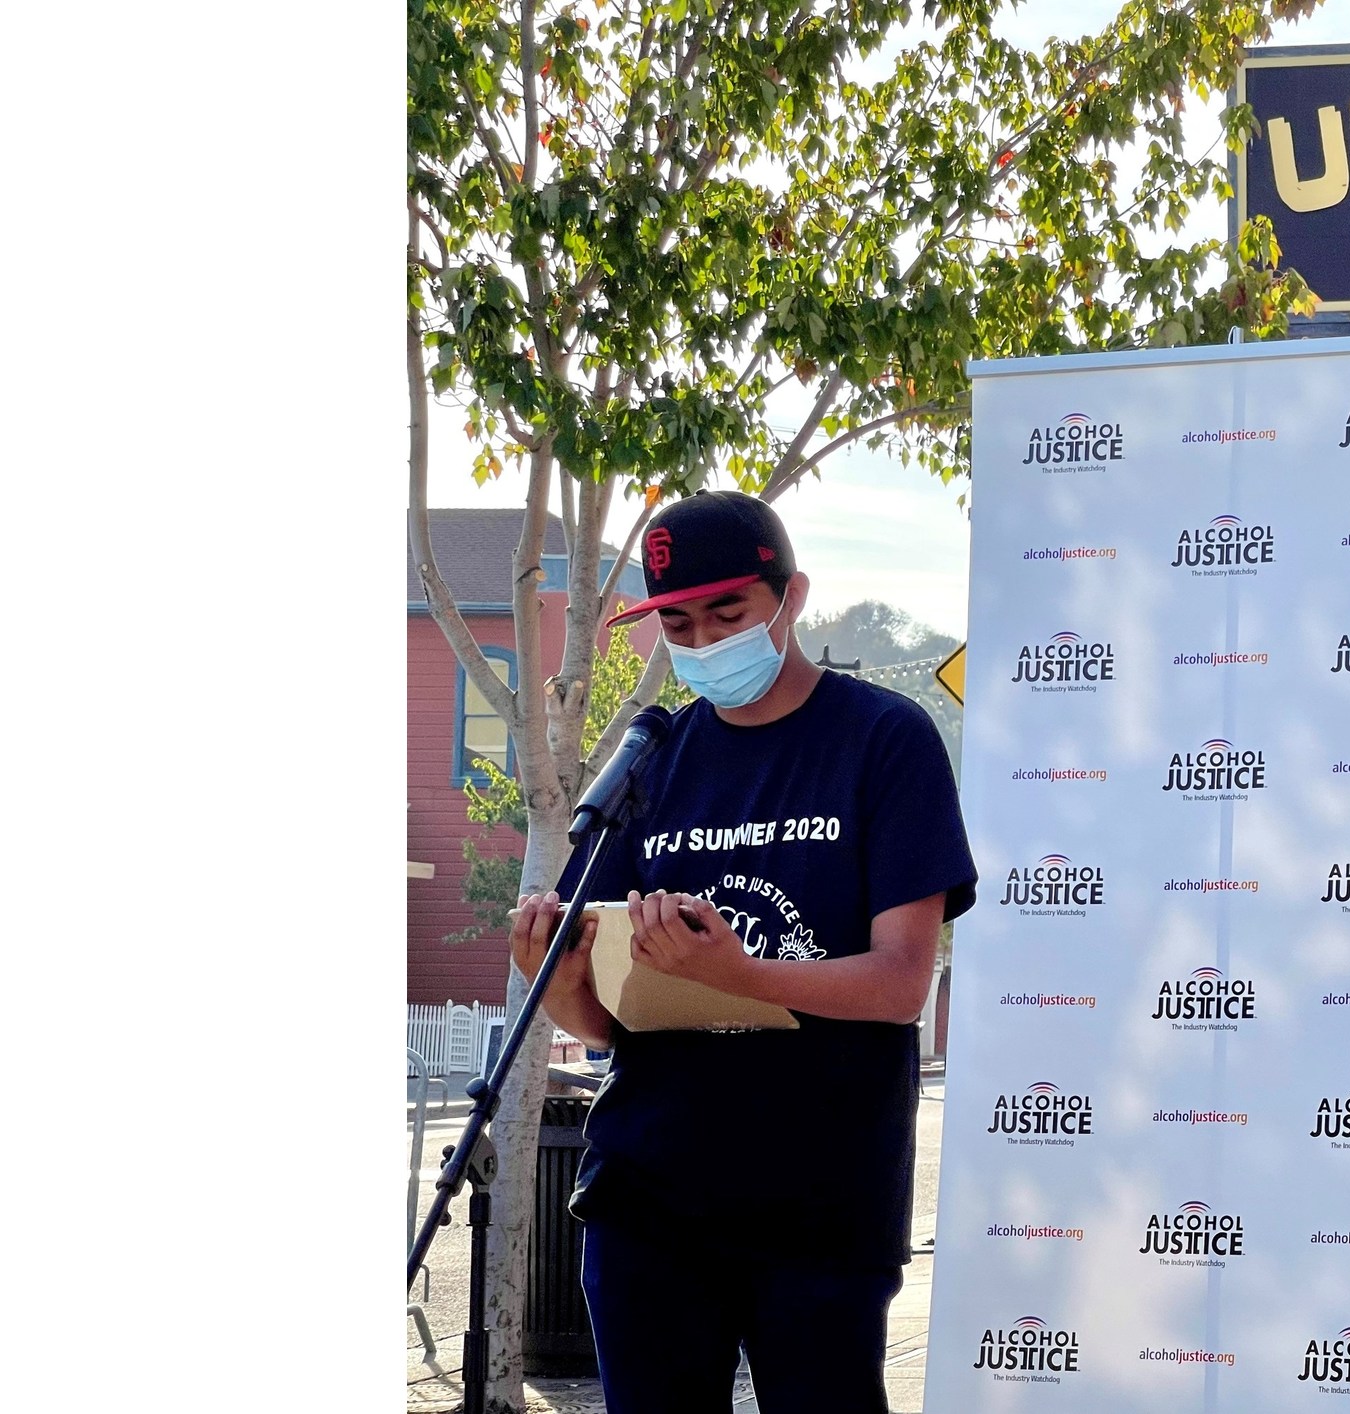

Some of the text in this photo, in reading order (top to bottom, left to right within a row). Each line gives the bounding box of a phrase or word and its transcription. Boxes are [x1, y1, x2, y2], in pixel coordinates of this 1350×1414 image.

[1029, 423, 1124, 442] ALCOHOL
[1181, 428, 1276, 445] alcoholjustice.org
[1022, 439, 1123, 465] JUSTICE
[1053, 466, 1077, 474] Industry
[1076, 464, 1107, 473] Watchdog
[1178, 525, 1274, 545] ALCOHOL
[1023, 547, 1117, 562] alcoholjustice.org
[1170, 541, 1274, 568] JUSTICE
[1203, 569, 1228, 578] Industry
[1227, 567, 1258, 576] Watchdog
[1018, 642, 1115, 660] ALCOHOL
[1173, 651, 1268, 668] alcoholjustice.org
[1010, 659, 1117, 683] JUSTICE
[1030, 684, 1097, 693] The Industry Watchdog
[1169, 750, 1266, 768] ALCOHOL
[1011, 767, 1107, 783] alcoholjustice.org
[1161, 767, 1265, 792] JUSTICE
[1193, 794, 1219, 803] Industry
[1218, 792, 1249, 802] Watchdog
[644, 816, 841, 859] YFJ SUMMER 2020
[1007, 866, 1104, 883] ALCOHOL
[999, 883, 1104, 906] JUSTICE
[1163, 878, 1259, 894] alcoholjustice.org
[747, 876, 801, 925] JUSTICE
[1019, 908, 1087, 918] The Industry Watchdog
[1158, 979, 1256, 997] ALCOHOL
[999, 992, 1096, 1009] alcoholjustice.org
[1151, 996, 1258, 1020] JUSTICE
[1171, 1022, 1238, 1032] The Industry Watchdog
[994, 1094, 1093, 1112] ALCOHOL
[986, 1111, 1093, 1135] JUSTICE
[1152, 1109, 1248, 1126] alcoholjustice.org
[1007, 1137, 1075, 1148] The Industry Watchdog
[1330, 1141, 1342, 1149] The
[1146, 1214, 1244, 1232] ALCOHOL
[986, 1223, 1084, 1242] alcoholjustice.org
[1138, 1231, 1244, 1256] JUSTICE
[1159, 1258, 1226, 1269] The Industry Watchdog
[980, 1329, 1079, 1348] ALCOHOL
[972, 1346, 1079, 1372] JUSTICE
[1138, 1347, 1235, 1367] alcoholjustice.org
[993, 1373, 1061, 1385] The Industry Watchdog
[1318, 1385, 1330, 1394] The
